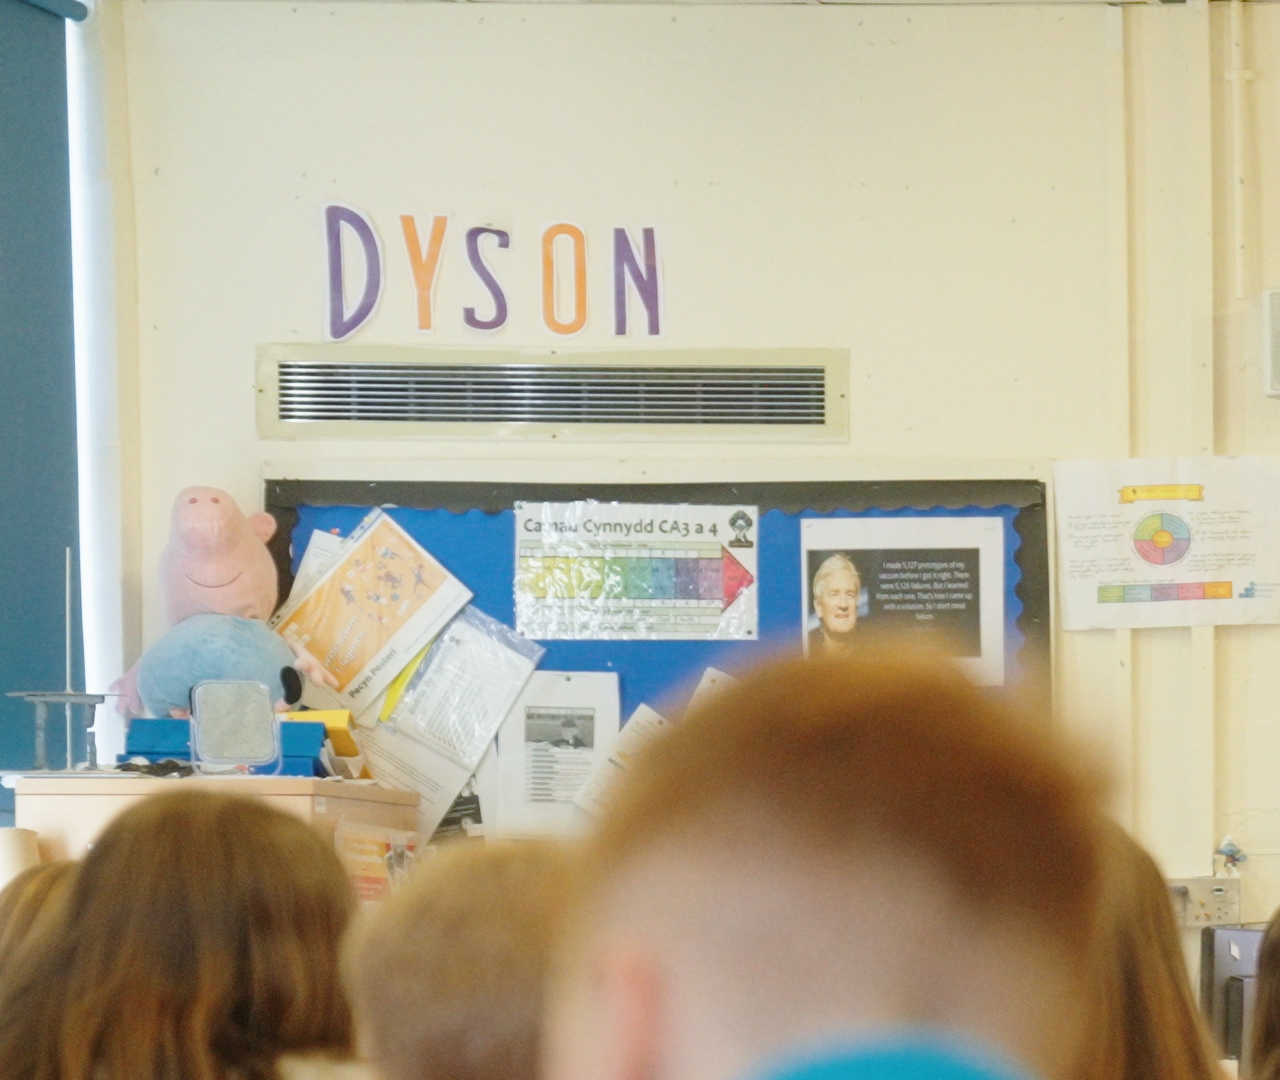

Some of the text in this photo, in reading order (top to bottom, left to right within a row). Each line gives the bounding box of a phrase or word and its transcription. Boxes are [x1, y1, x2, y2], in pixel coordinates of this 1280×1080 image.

[325, 205, 660, 339] DYSON
[583, 518, 654, 537] Cynnydd
[660, 519, 690, 537] CA3
[695, 523, 704, 534] a
[708, 522, 719, 537] 4
[902, 561, 918, 571] 5,127
[323, 615, 359, 667] wricwlwm
[348, 675, 373, 699] Pecyn
